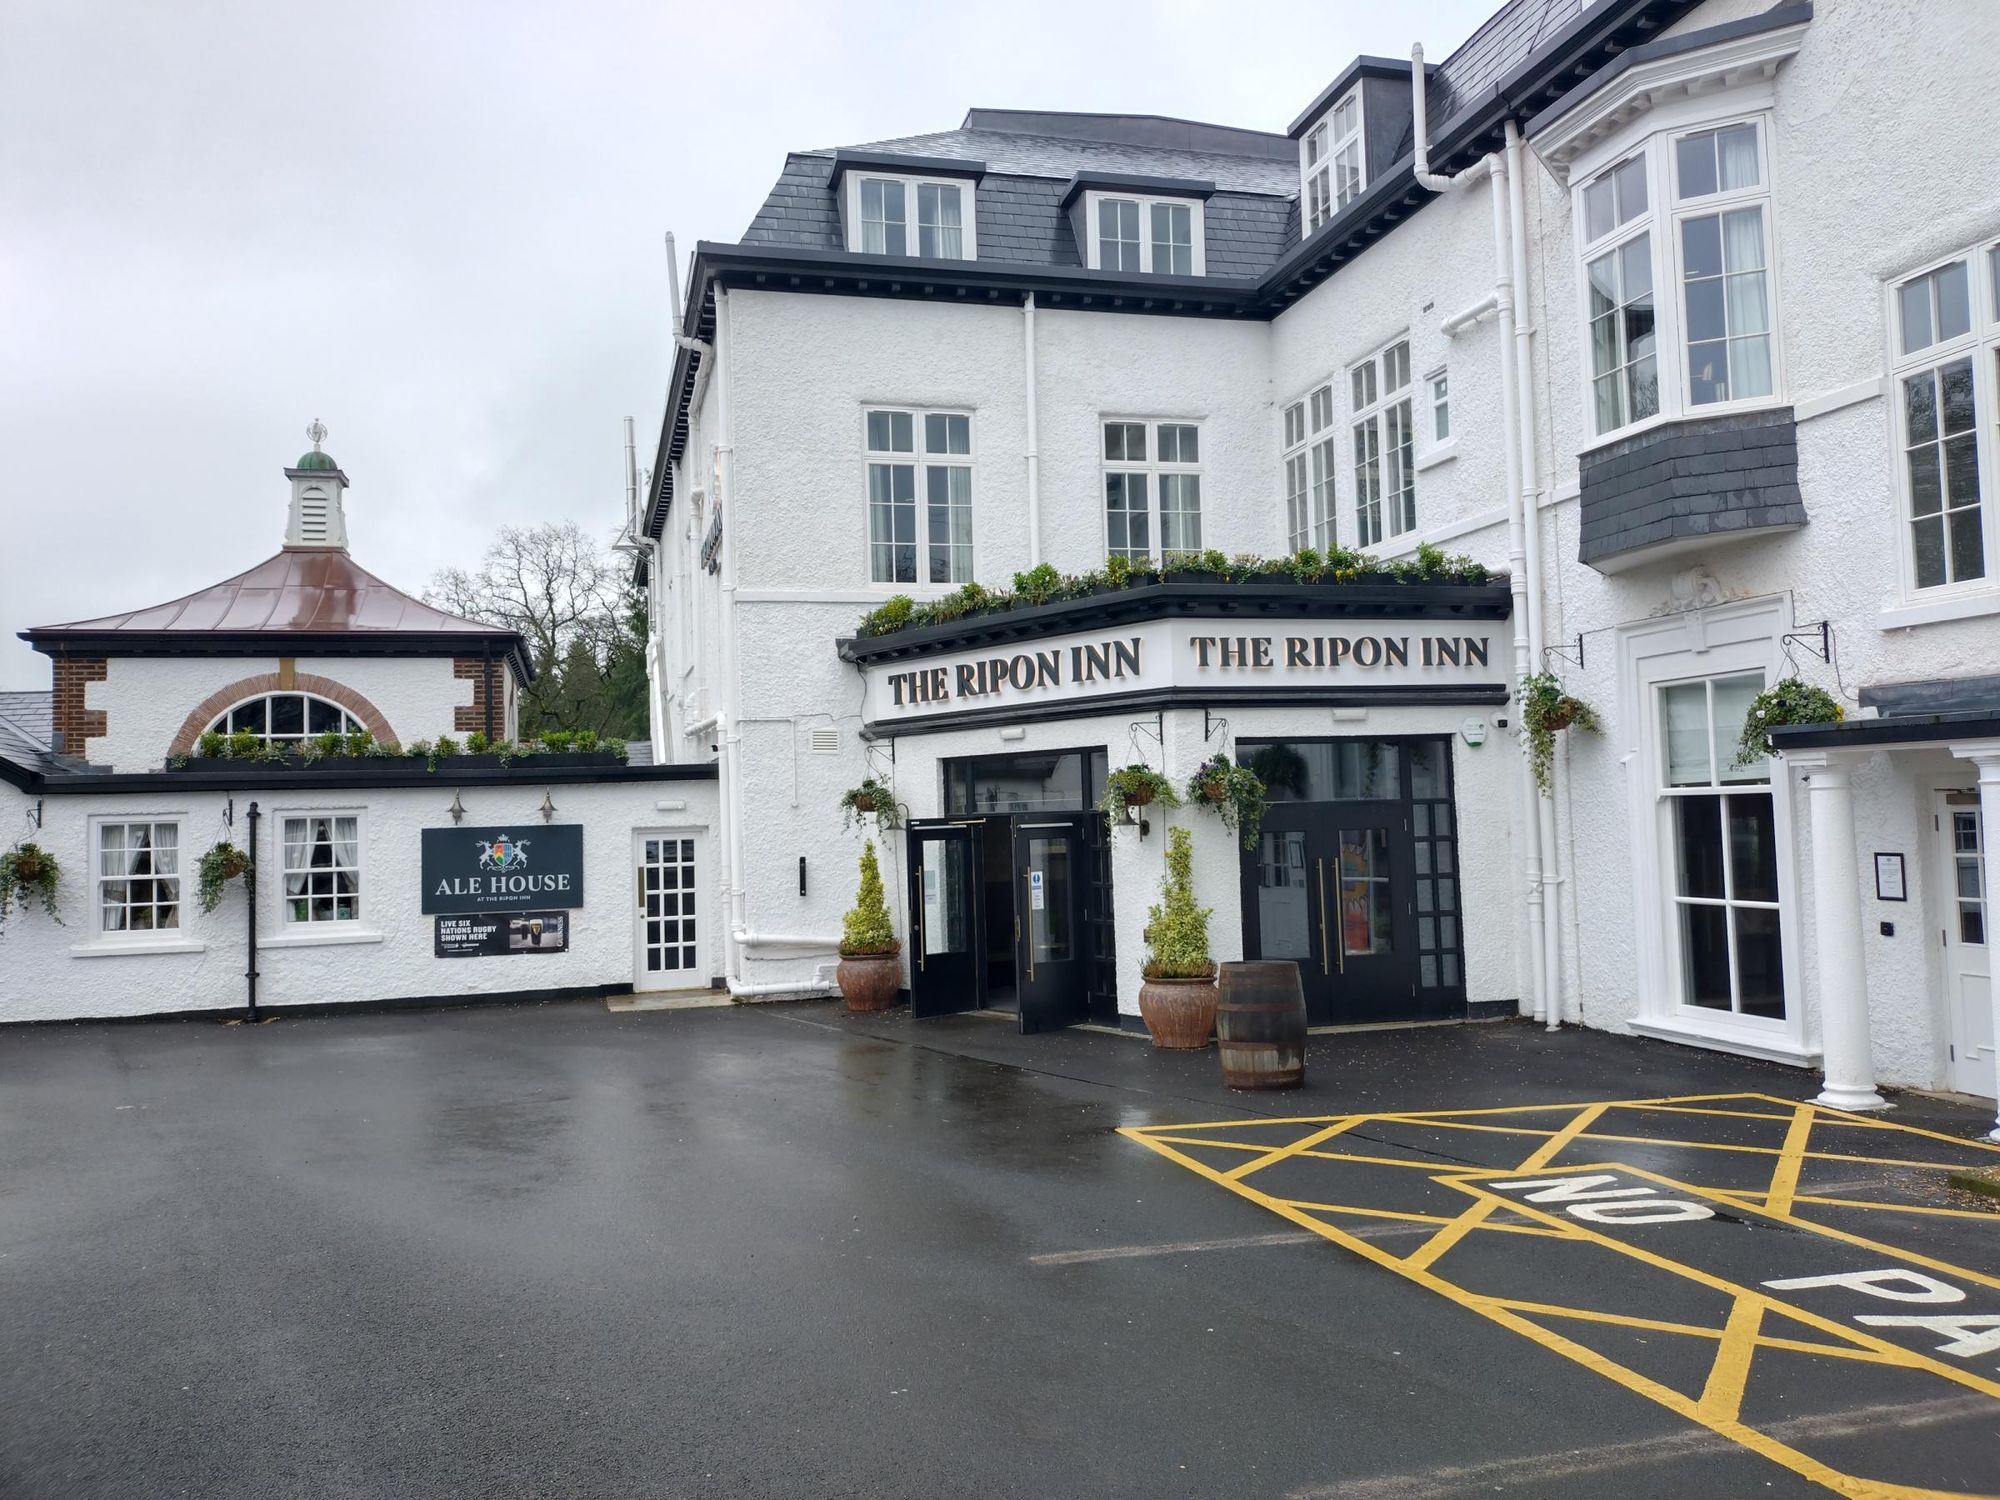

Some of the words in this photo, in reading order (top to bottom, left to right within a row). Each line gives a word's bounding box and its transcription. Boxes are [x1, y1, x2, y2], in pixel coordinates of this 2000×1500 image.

[1190, 637, 1274, 668] THE
[1285, 637, 1410, 668] RIPON
[1421, 637, 1490, 668] INN
[888, 667, 949, 706] THE
[955, 650, 1062, 698] RIPON
[1070, 637, 1142, 683] INN
[435, 877, 482, 896] ALE
[491, 874, 571, 894] HOUSE
[441, 926, 472, 935] NATIONS
[473, 925, 497, 934] RUGBY
[458, 919, 471, 927] SIX
[441, 933, 468, 942] SHOWN
[469, 932, 488, 941] HERE
[1488, 1175, 1716, 1225] NO
[1760, 1268, 2000, 1372] PA
